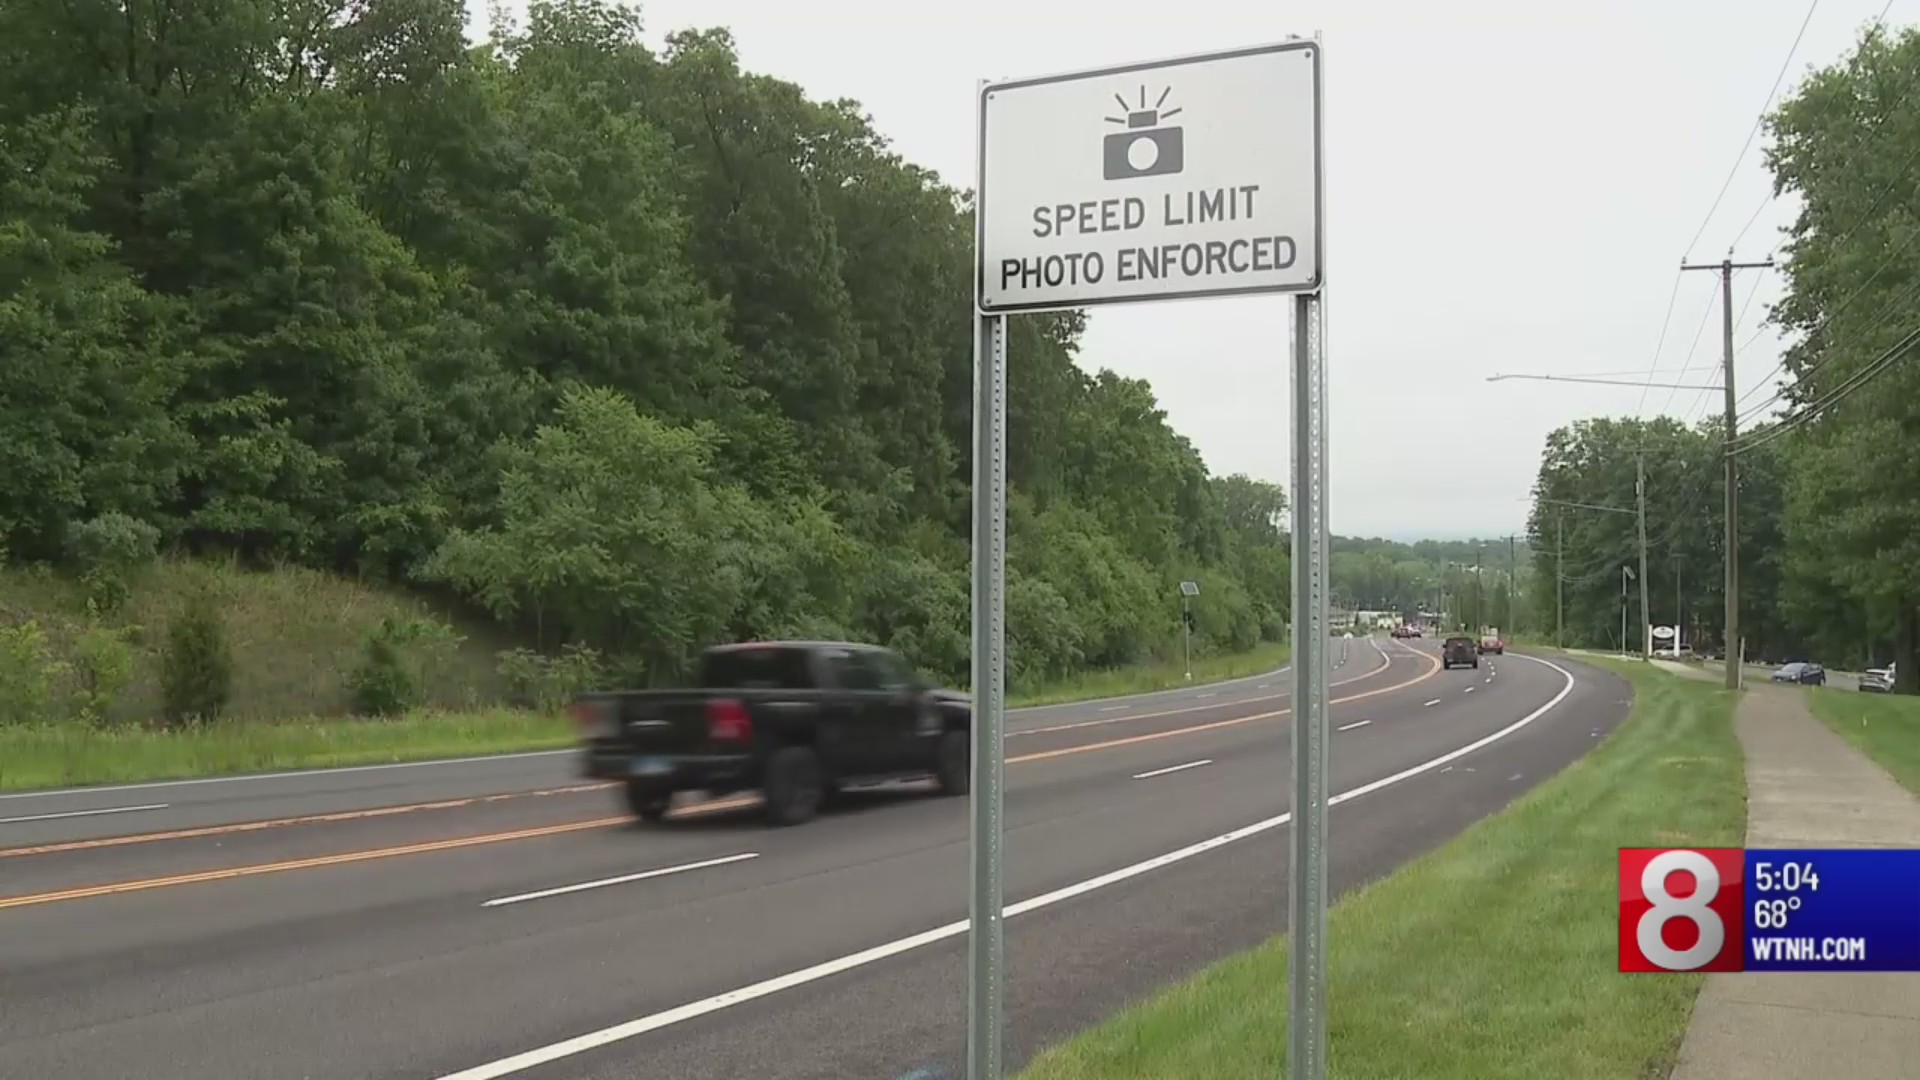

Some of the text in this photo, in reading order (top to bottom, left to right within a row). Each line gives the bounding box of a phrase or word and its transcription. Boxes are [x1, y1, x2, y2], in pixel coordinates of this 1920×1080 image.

[1032, 185, 1259, 238] SPEED LIMIT
[1001, 235, 1297, 291] PHOTO ENFORCED
